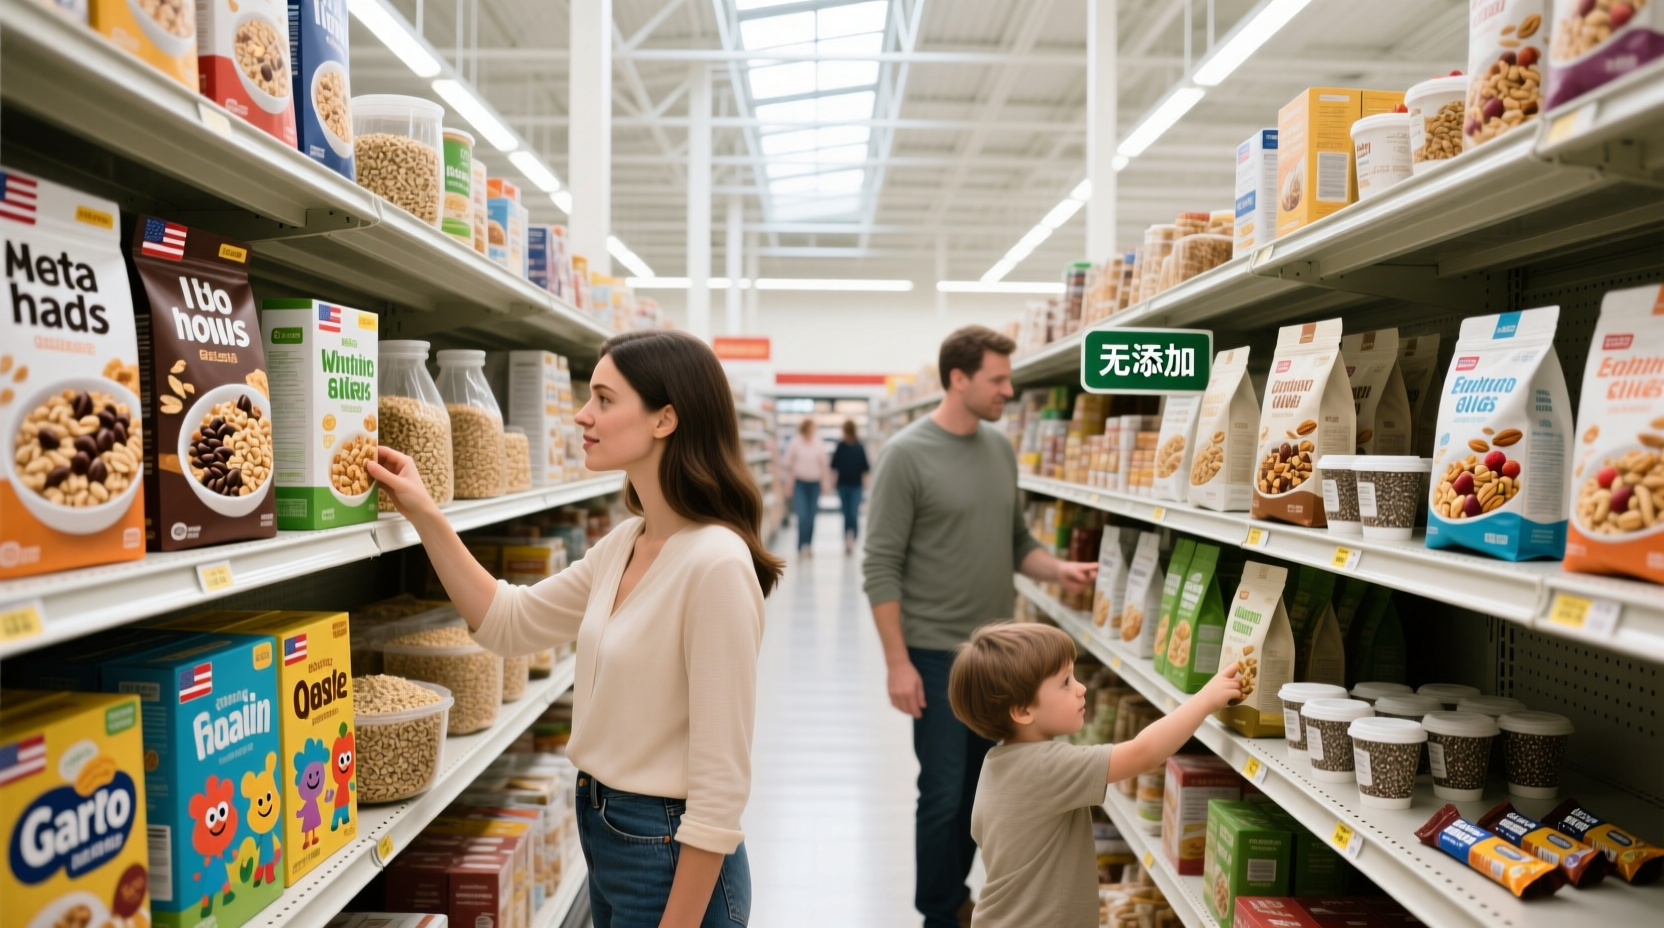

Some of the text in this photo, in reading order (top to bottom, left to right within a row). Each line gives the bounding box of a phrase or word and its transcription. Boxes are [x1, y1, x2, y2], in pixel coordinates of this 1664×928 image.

[5, 239, 98, 293] Meta
[10, 282, 110, 335] hads
[1099, 343, 1195, 377] 无添加
